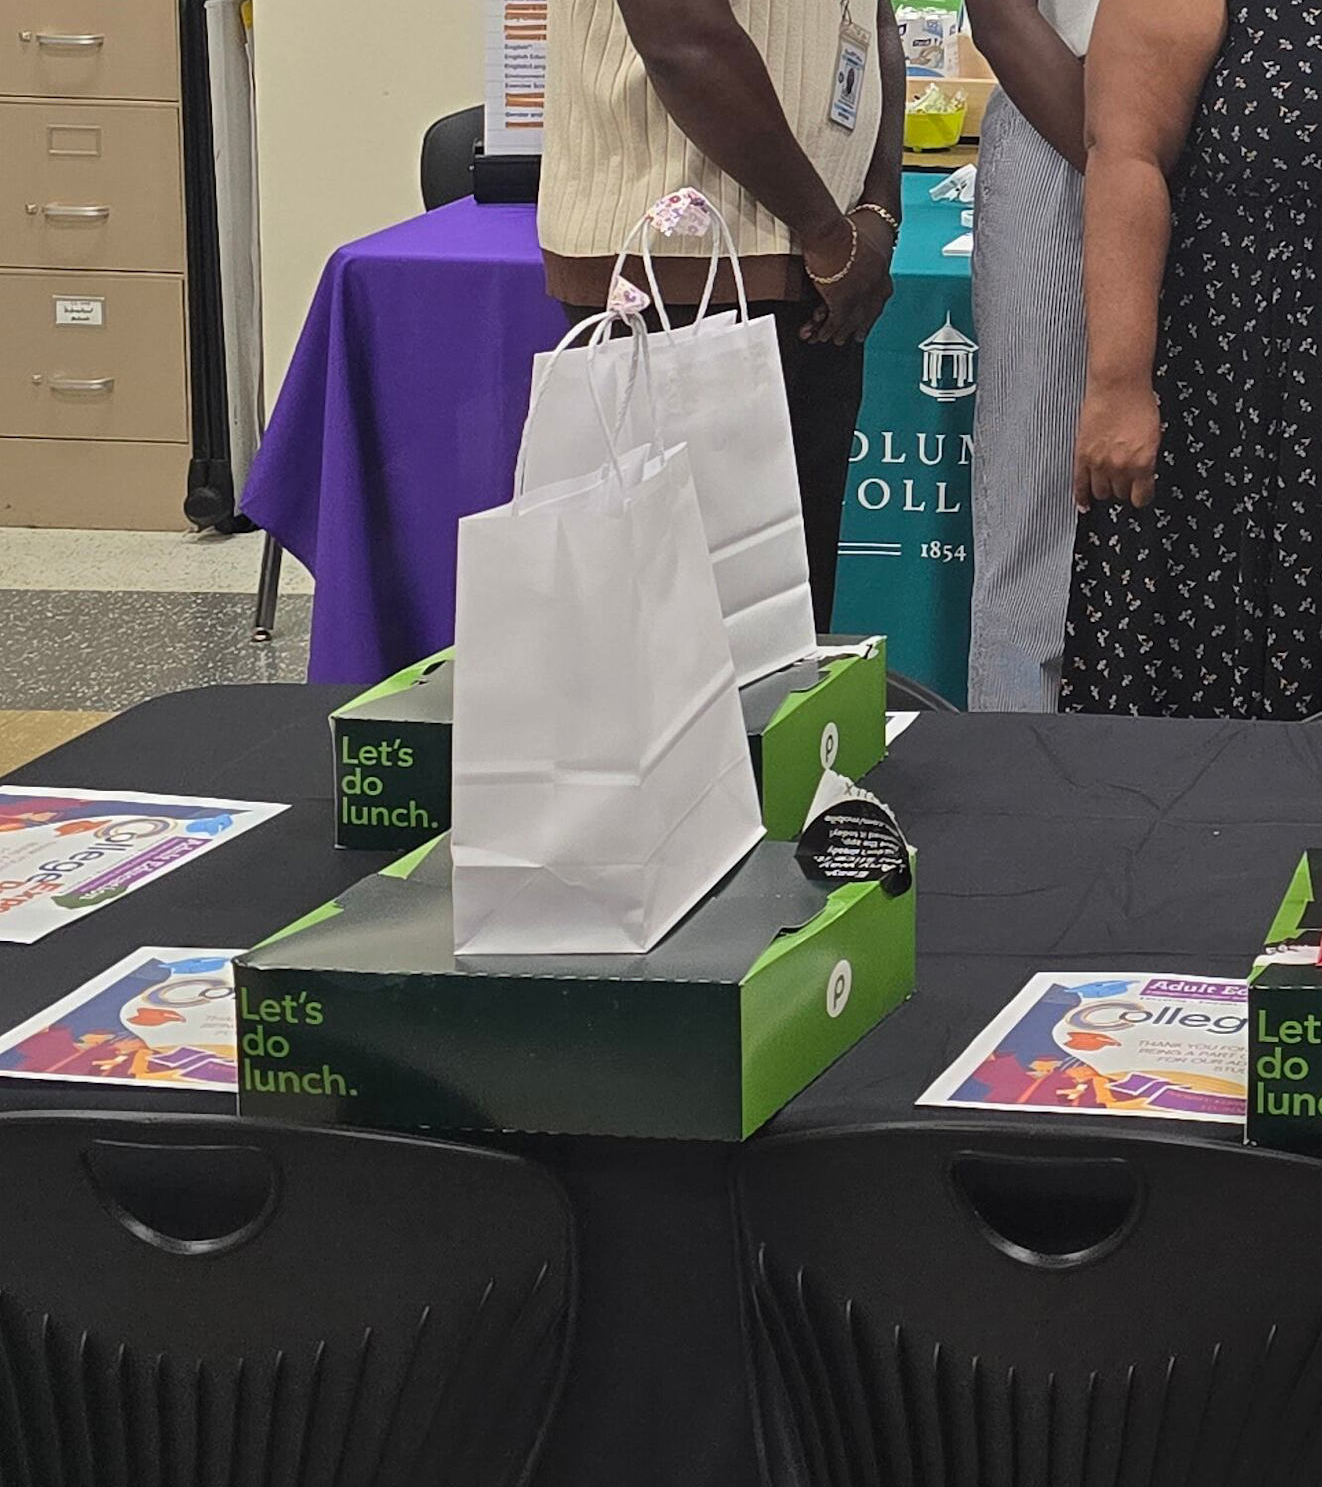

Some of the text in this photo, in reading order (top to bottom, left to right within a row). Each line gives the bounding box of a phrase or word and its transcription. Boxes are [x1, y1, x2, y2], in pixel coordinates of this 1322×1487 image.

[920, 540, 967, 563] 1854
[342, 736, 414, 767] Let's
[341, 767, 384, 795] do
[342, 796, 438, 828] lunch.
[1150, 980, 1217, 994] Adult
[240, 987, 324, 1025] Let's
[242, 1025, 290, 1059] do
[1187, 1043, 1217, 1051] YOU
[244, 1058, 358, 1097] lunch.
[1257, 1046, 1309, 1080] do
